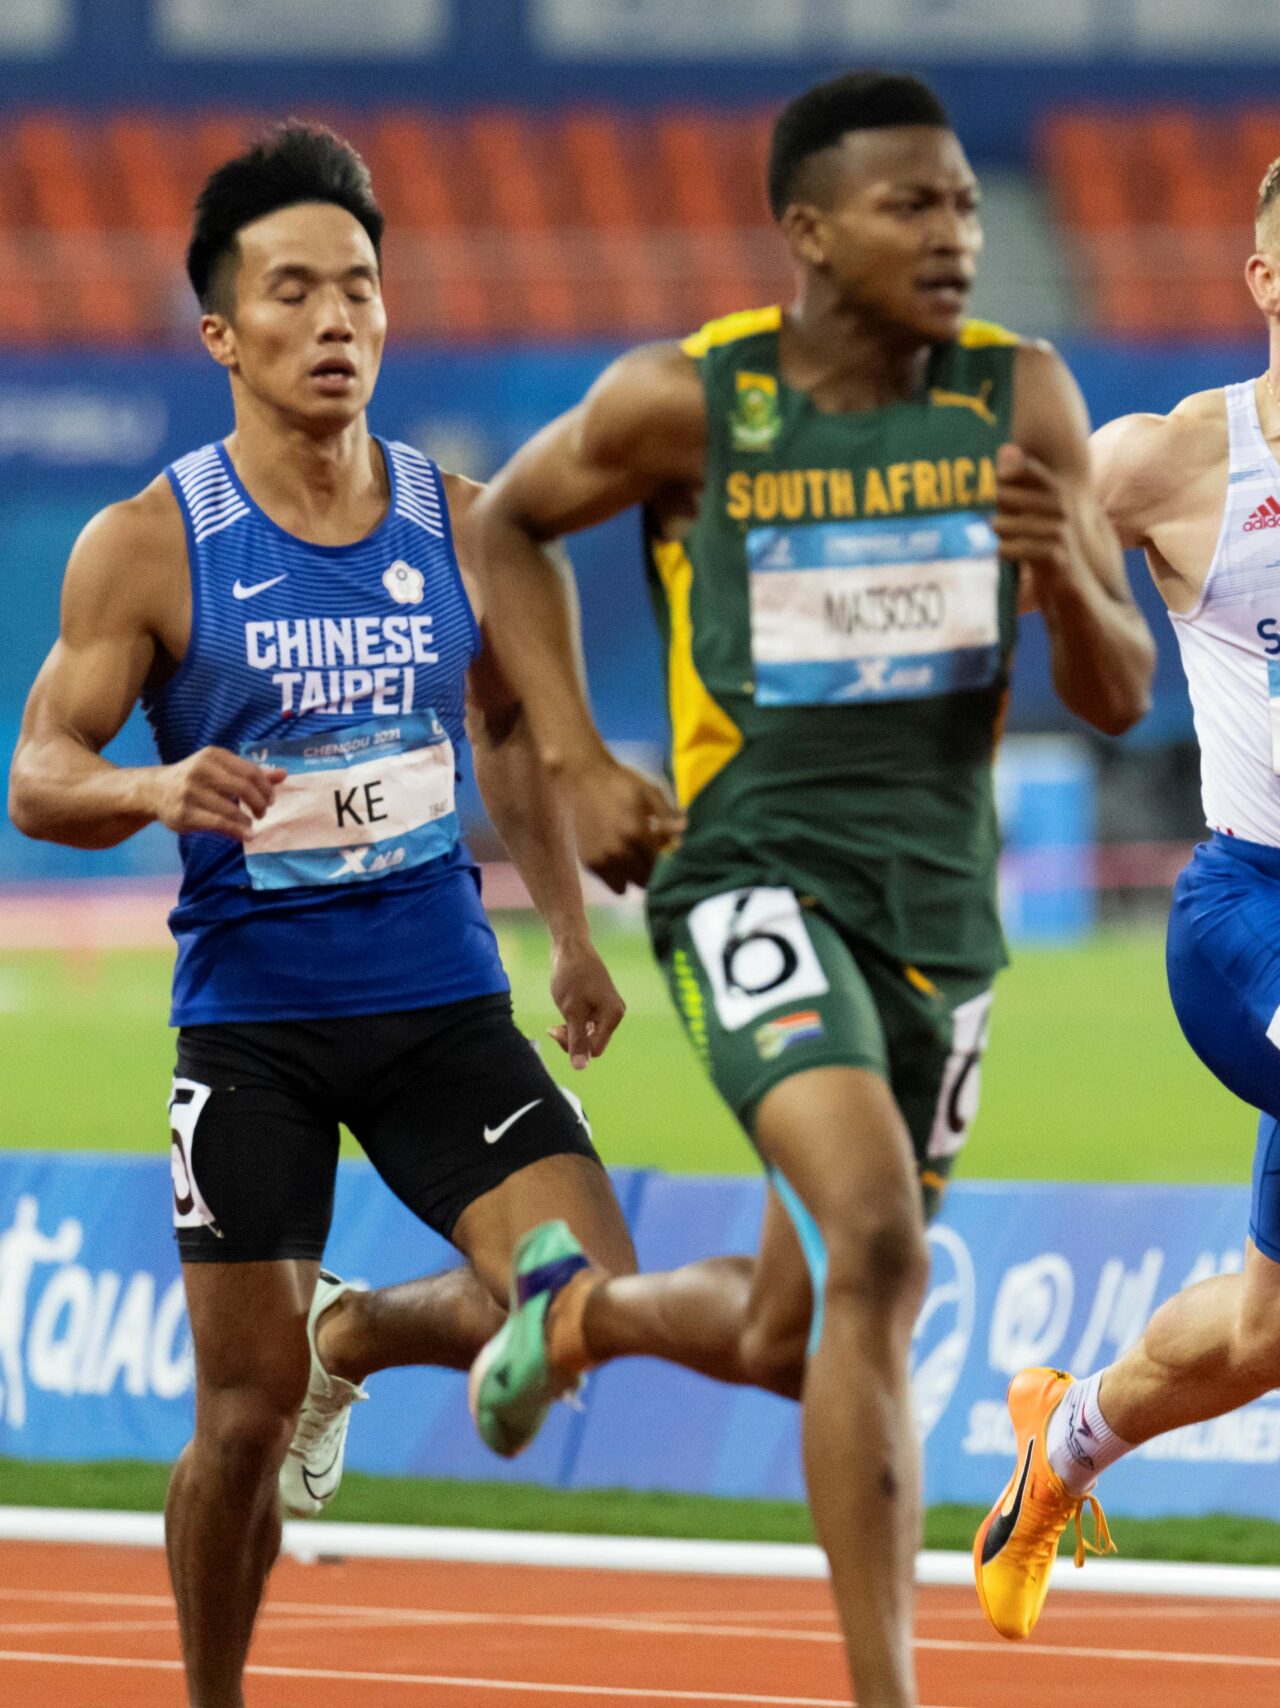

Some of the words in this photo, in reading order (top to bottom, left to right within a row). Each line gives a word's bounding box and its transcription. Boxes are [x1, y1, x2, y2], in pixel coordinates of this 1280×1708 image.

[726, 469, 857, 521] SOUTH
[863, 457, 998, 515] AFRICA
[245, 615, 440, 670] CHINESE
[272, 667, 416, 716] TAIPEI
[334, 780, 388, 828] KE
[722, 892, 799, 996] 6
